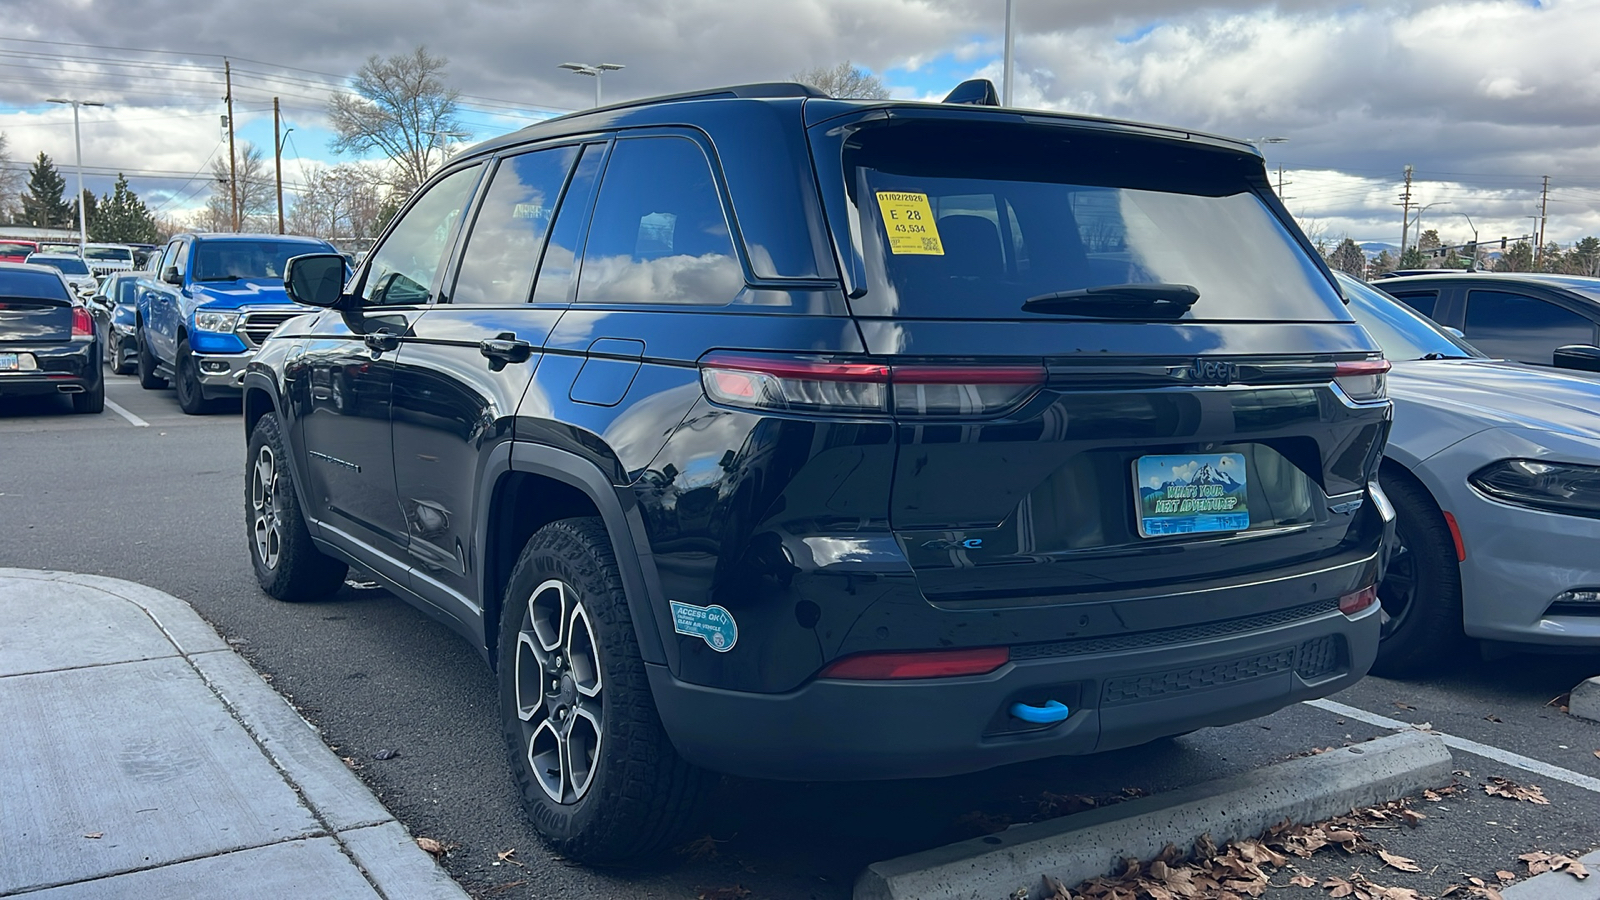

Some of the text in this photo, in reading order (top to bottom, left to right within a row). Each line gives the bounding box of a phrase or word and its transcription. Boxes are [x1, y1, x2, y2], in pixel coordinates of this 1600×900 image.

[878, 193, 924, 202] 01/02/2026
[890, 209, 922, 221] E 28
[895, 224, 926, 234] 43,534
[1189, 358, 1240, 384] Jeep
[1167, 484, 1224, 499] WHAT'S YOUR
[1155, 496, 1238, 514] NEXT ADVENTURE?
[677, 607, 707, 619] ACCESS
[708, 613, 720, 622] OK
[677, 618, 693, 626] CLEAN
[702, 623, 721, 632] VEHICLE
